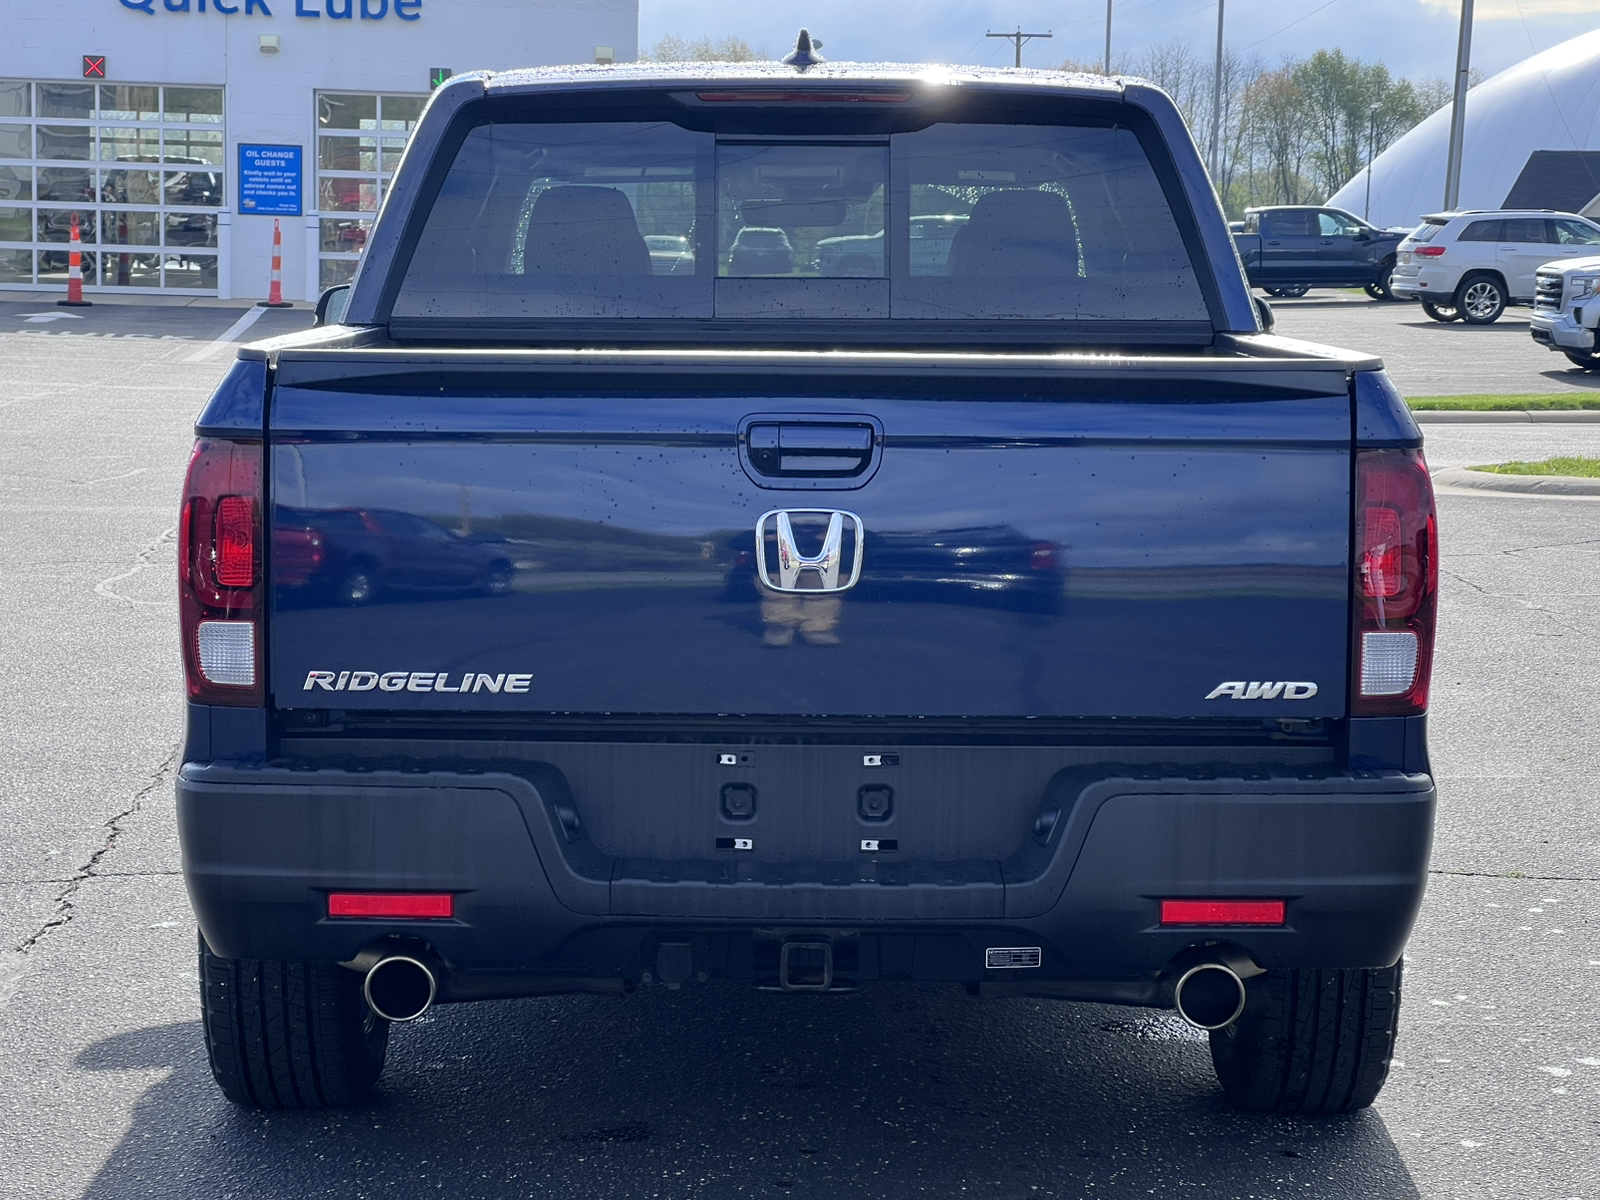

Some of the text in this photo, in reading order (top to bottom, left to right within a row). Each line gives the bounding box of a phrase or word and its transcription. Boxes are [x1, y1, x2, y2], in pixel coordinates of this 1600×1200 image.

[254, 159, 286, 167] GUESTS
[303, 670, 534, 693] RIDGELINE
[1204, 681, 1318, 700] AWD
